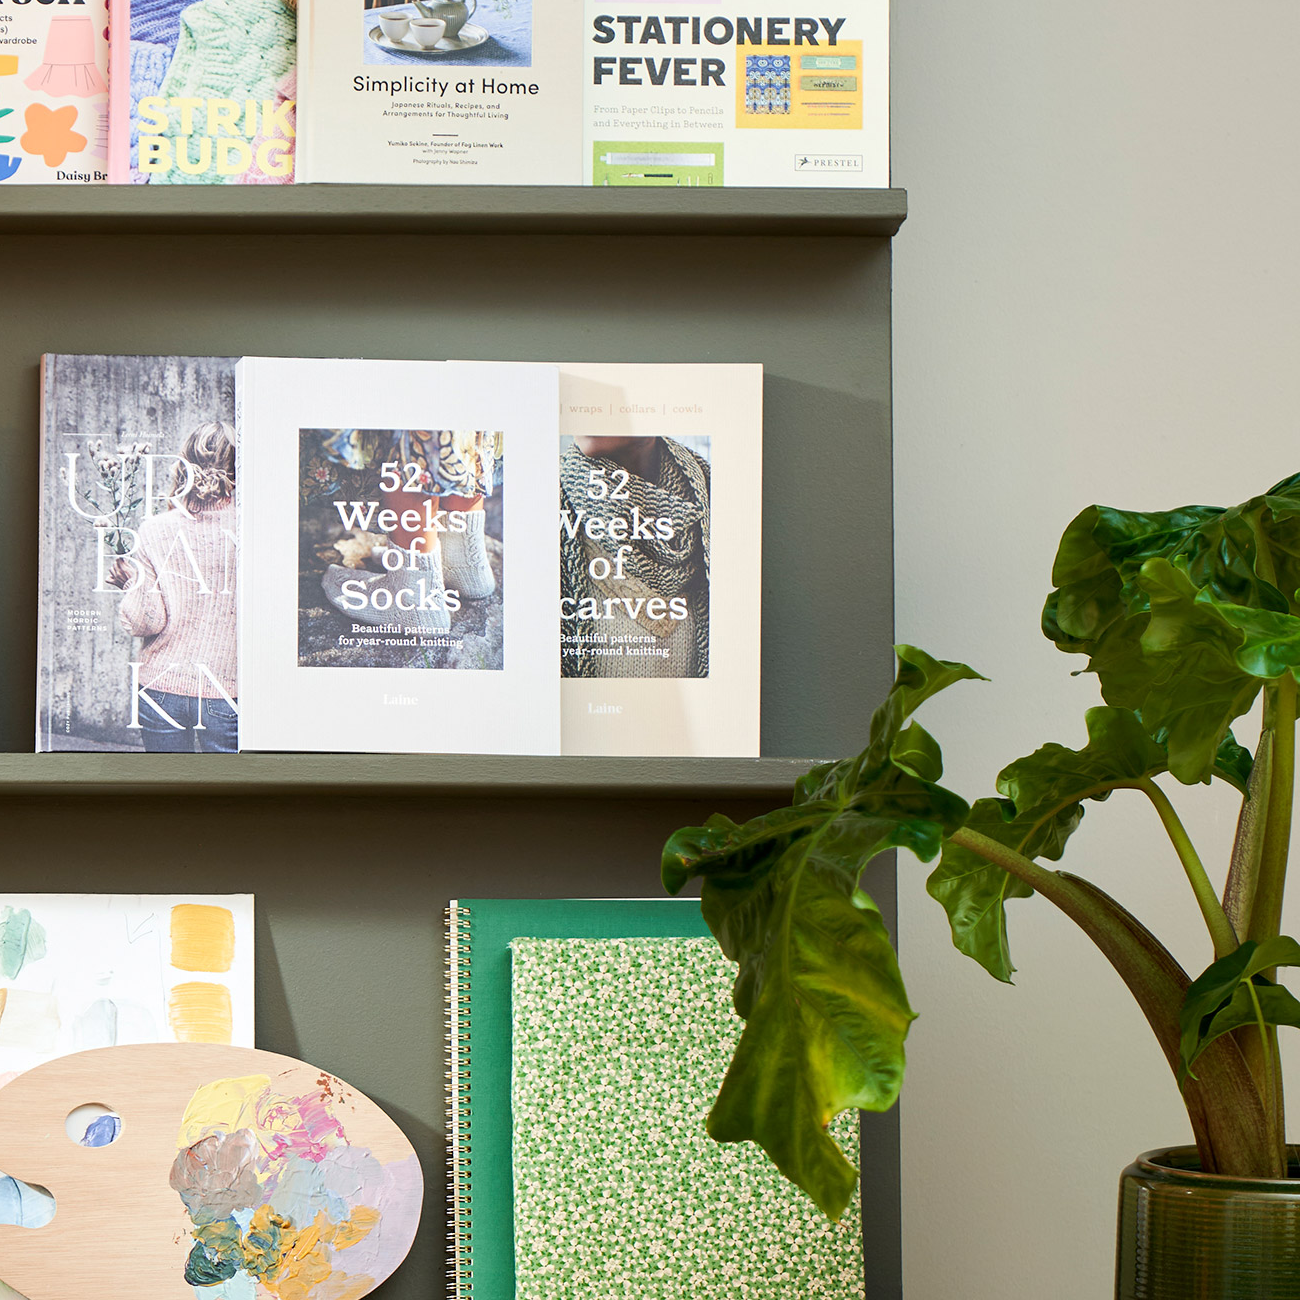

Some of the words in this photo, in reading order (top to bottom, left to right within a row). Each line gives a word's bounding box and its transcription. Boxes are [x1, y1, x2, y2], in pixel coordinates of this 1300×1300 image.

[592, 15, 846, 47] STATIONERY
[593, 55, 727, 87] FEVER
[353, 75, 449, 97] Simplicity
[455, 78, 475, 94] at
[482, 78, 540, 95] Home
[391, 101, 425, 110] Japanese
[426, 102, 453, 110] Rituals,
[455, 102, 485, 112] Recipes,
[593, 104, 620, 115] From
[620, 106, 649, 116] Paper
[649, 105, 676, 117] Clips
[677, 106, 688, 115] to
[689, 106, 724, 116] Pencils
[136, 95, 296, 138] STRIK
[382, 110, 434, 119] Arrangements
[447, 111, 486, 120] Thoughtful
[488, 112, 509, 120] Living
[592, 118, 612, 128] and
[612, 118, 669, 130] Everything
[670, 119, 682, 129] in
[683, 120, 724, 129] Between
[462, 142, 472, 150] Fog
[137, 134, 294, 175] BUDG
[814, 159, 860, 168] PRESTEL
[56, 170, 91, 183] Daisy
[93, 171, 108, 181] Br
[569, 404, 603, 416] wraps
[619, 404, 656, 414] collars
[672, 404, 704, 414] cowls
[378, 461, 423, 493] 52
[586, 468, 630, 500] 52
[64, 452, 197, 521] UR
[333, 499, 468, 533] Weeks
[381, 536, 427, 572] of
[587, 544, 633, 581] of
[340, 578, 462, 612] Socks
[351, 623, 402, 634] Beautiful
[404, 624, 450, 636] patterns
[338, 635, 355, 646] for
[356, 636, 418, 648] year-round
[420, 636, 464, 650] knitting
[610, 633, 657, 646] patterns
[562, 646, 624, 658] year-round
[626, 646, 670, 658] knitting
[383, 694, 419, 706] Laine
[587, 702, 624, 715] Laine
